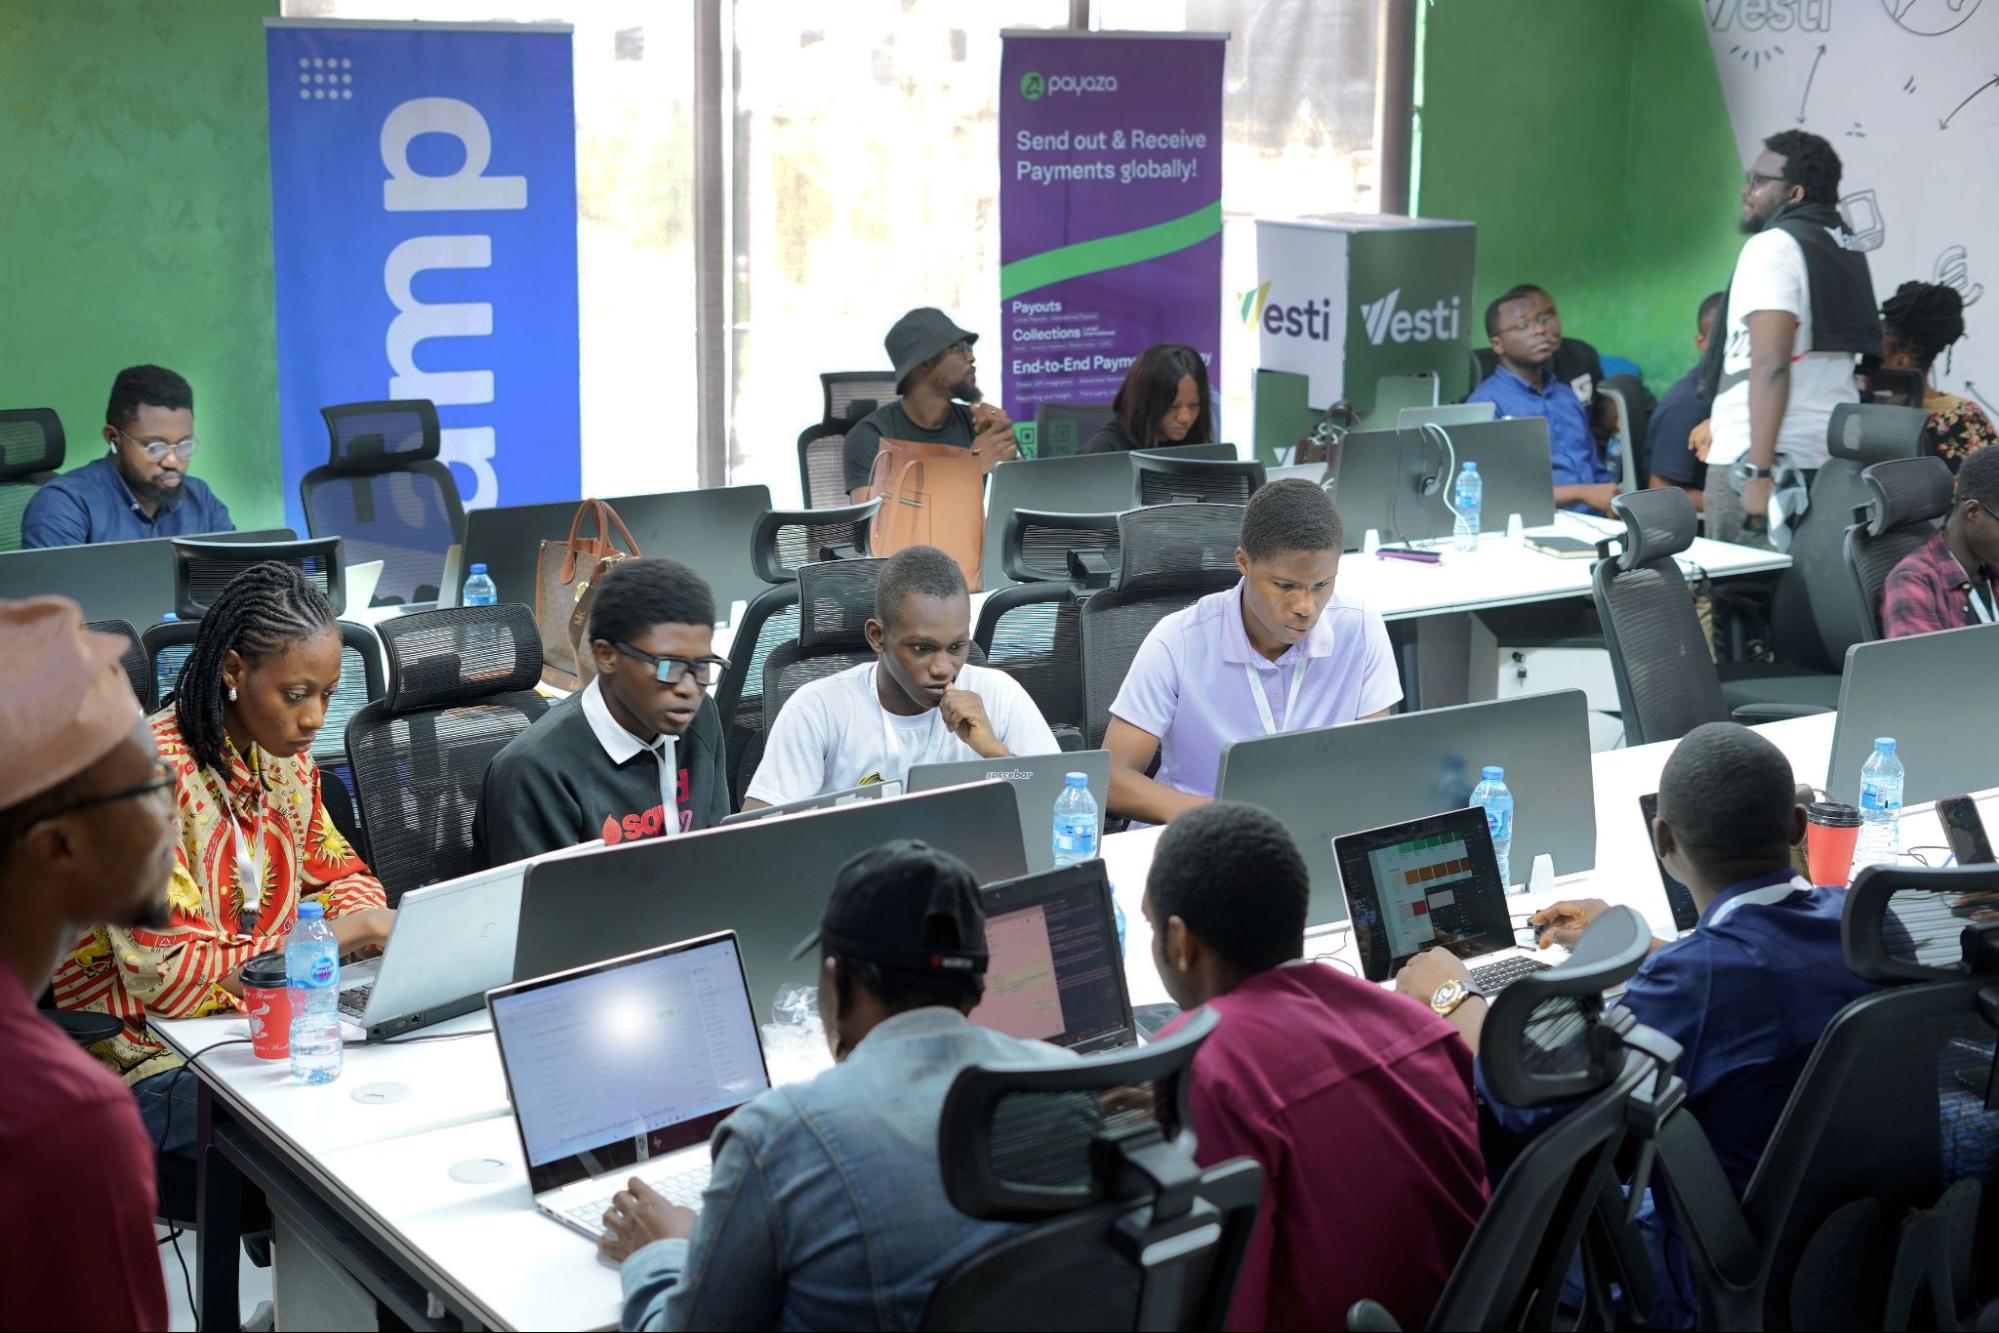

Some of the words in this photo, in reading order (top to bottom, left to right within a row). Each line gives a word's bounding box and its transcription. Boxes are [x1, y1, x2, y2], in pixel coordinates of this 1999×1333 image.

[1048, 75, 1118, 96] payaza
[1017, 130, 1069, 151] Send
[1074, 131, 1106, 150] out
[1112, 130, 1126, 150] &
[1131, 129, 1207, 149] Receive
[1017, 160, 1116, 185] Payments
[1120, 158, 1197, 184] globally!
[1012, 301, 1062, 316] Payouts
[1236, 280, 1330, 342] Vesti
[1360, 287, 1461, 346] Vesti
[1012, 327, 1081, 342] Collections
[1012, 356, 1090, 375] End-to-End
